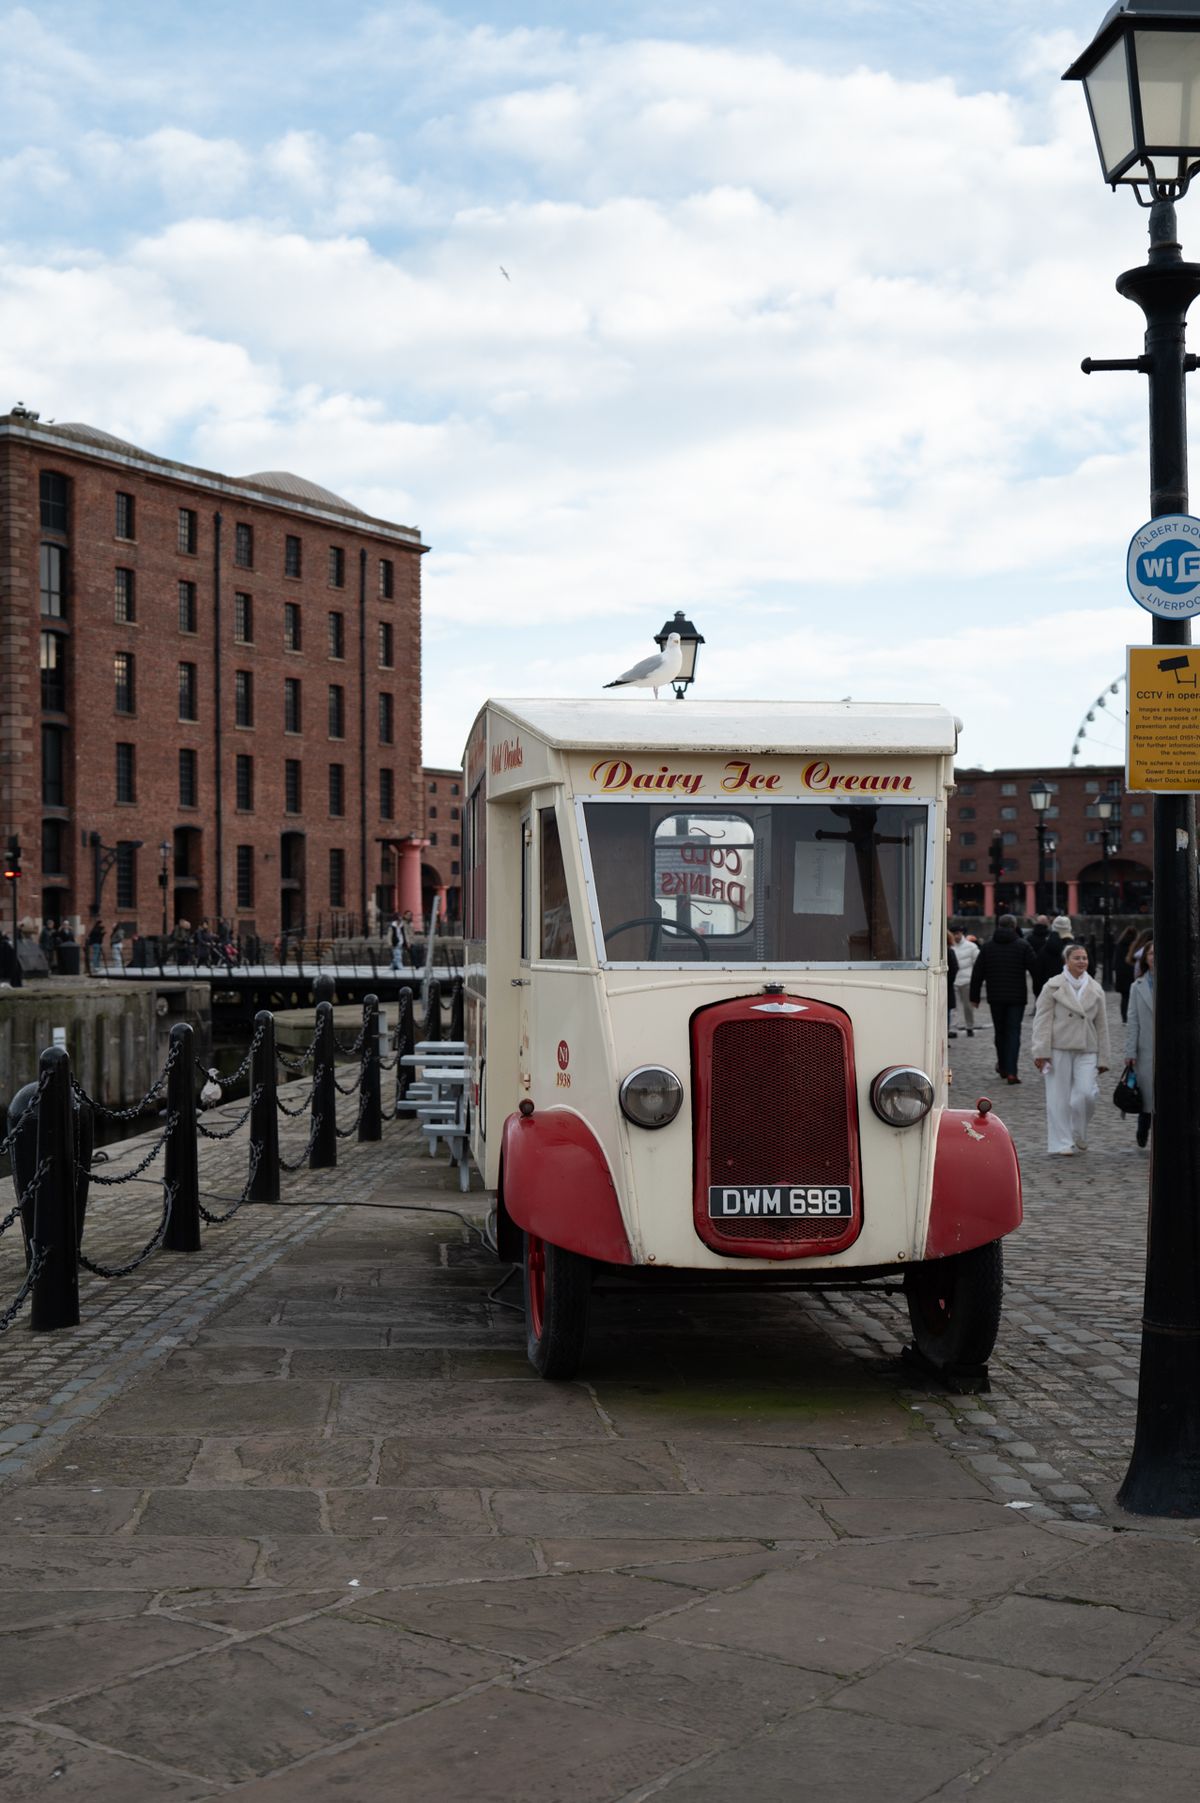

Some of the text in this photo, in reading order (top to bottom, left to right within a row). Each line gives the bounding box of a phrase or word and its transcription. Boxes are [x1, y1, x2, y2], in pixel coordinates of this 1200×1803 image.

[1139, 523, 1200, 549] ALBERT DO
[1136, 690, 1200, 701] CCTV in oper
[590, 759, 916, 795] Dairy Ice Cream
[556, 1072, 571, 1088] 1938
[722, 1189, 842, 1215] DWM 698
